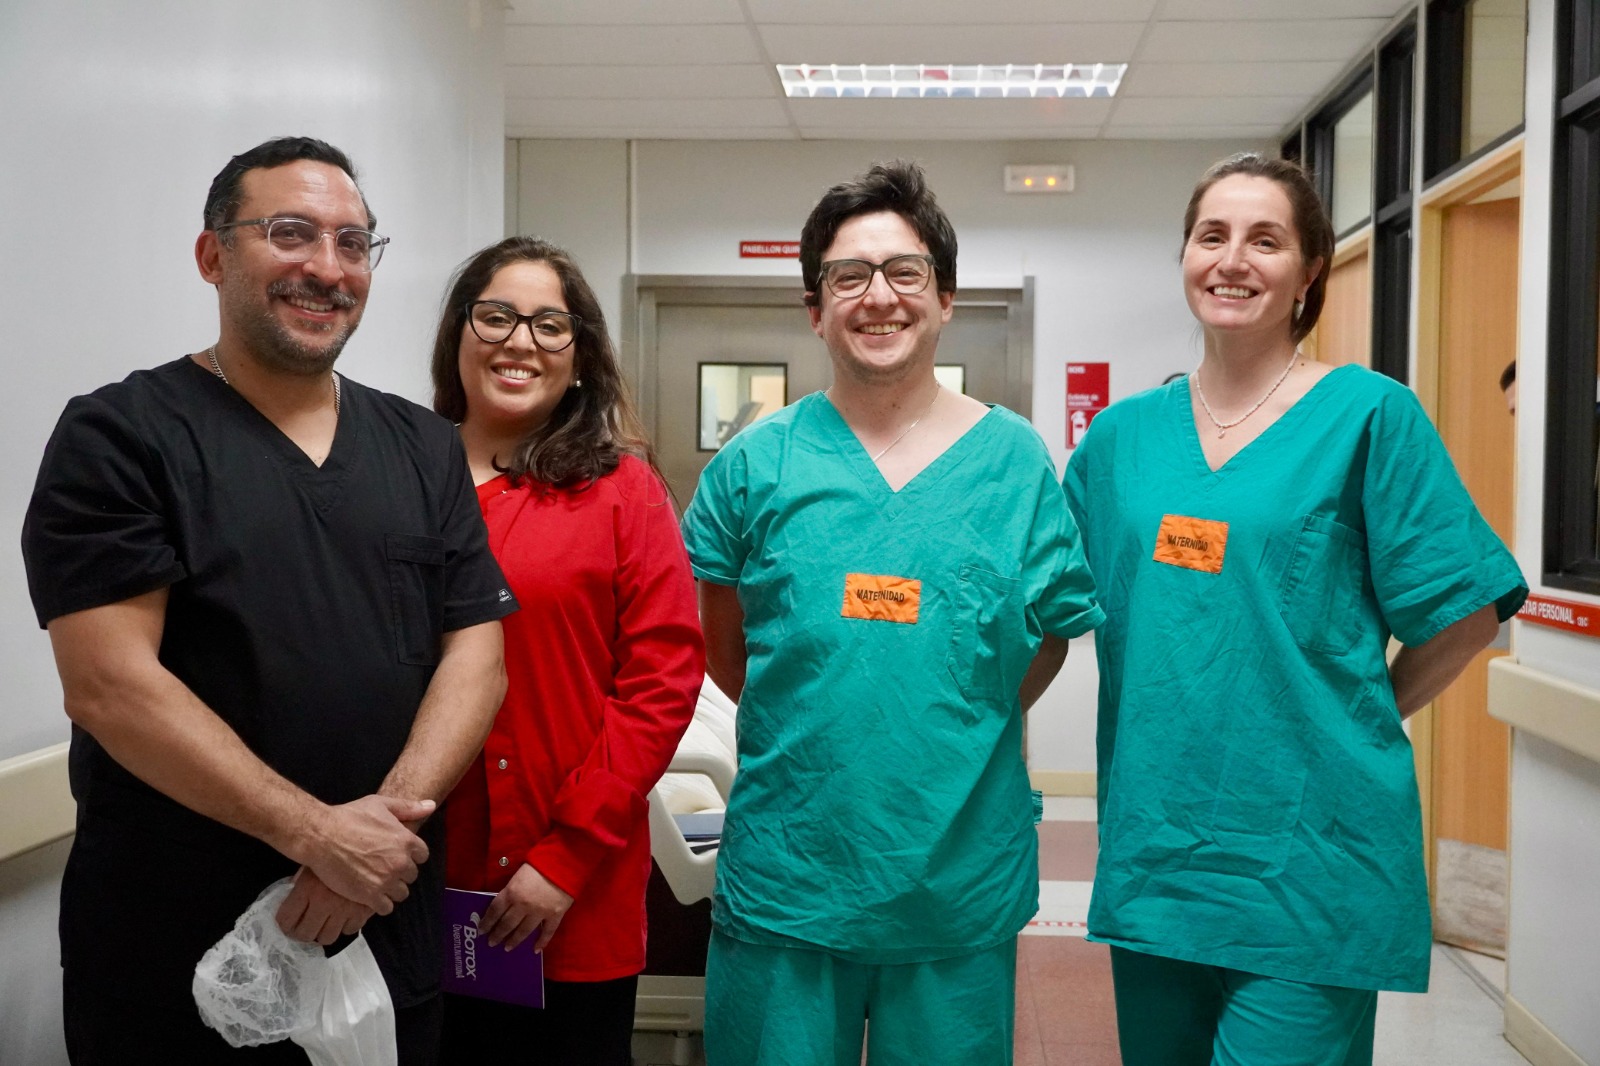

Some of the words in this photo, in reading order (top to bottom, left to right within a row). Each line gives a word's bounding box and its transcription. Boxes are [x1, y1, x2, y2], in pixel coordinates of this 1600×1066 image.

[742, 244, 781, 254] PABELLON
[856, 589, 905, 602] MATERNIDAD
[1537, 602, 1575, 624] PERSONAL
[463, 925, 478, 978] BOTOX
